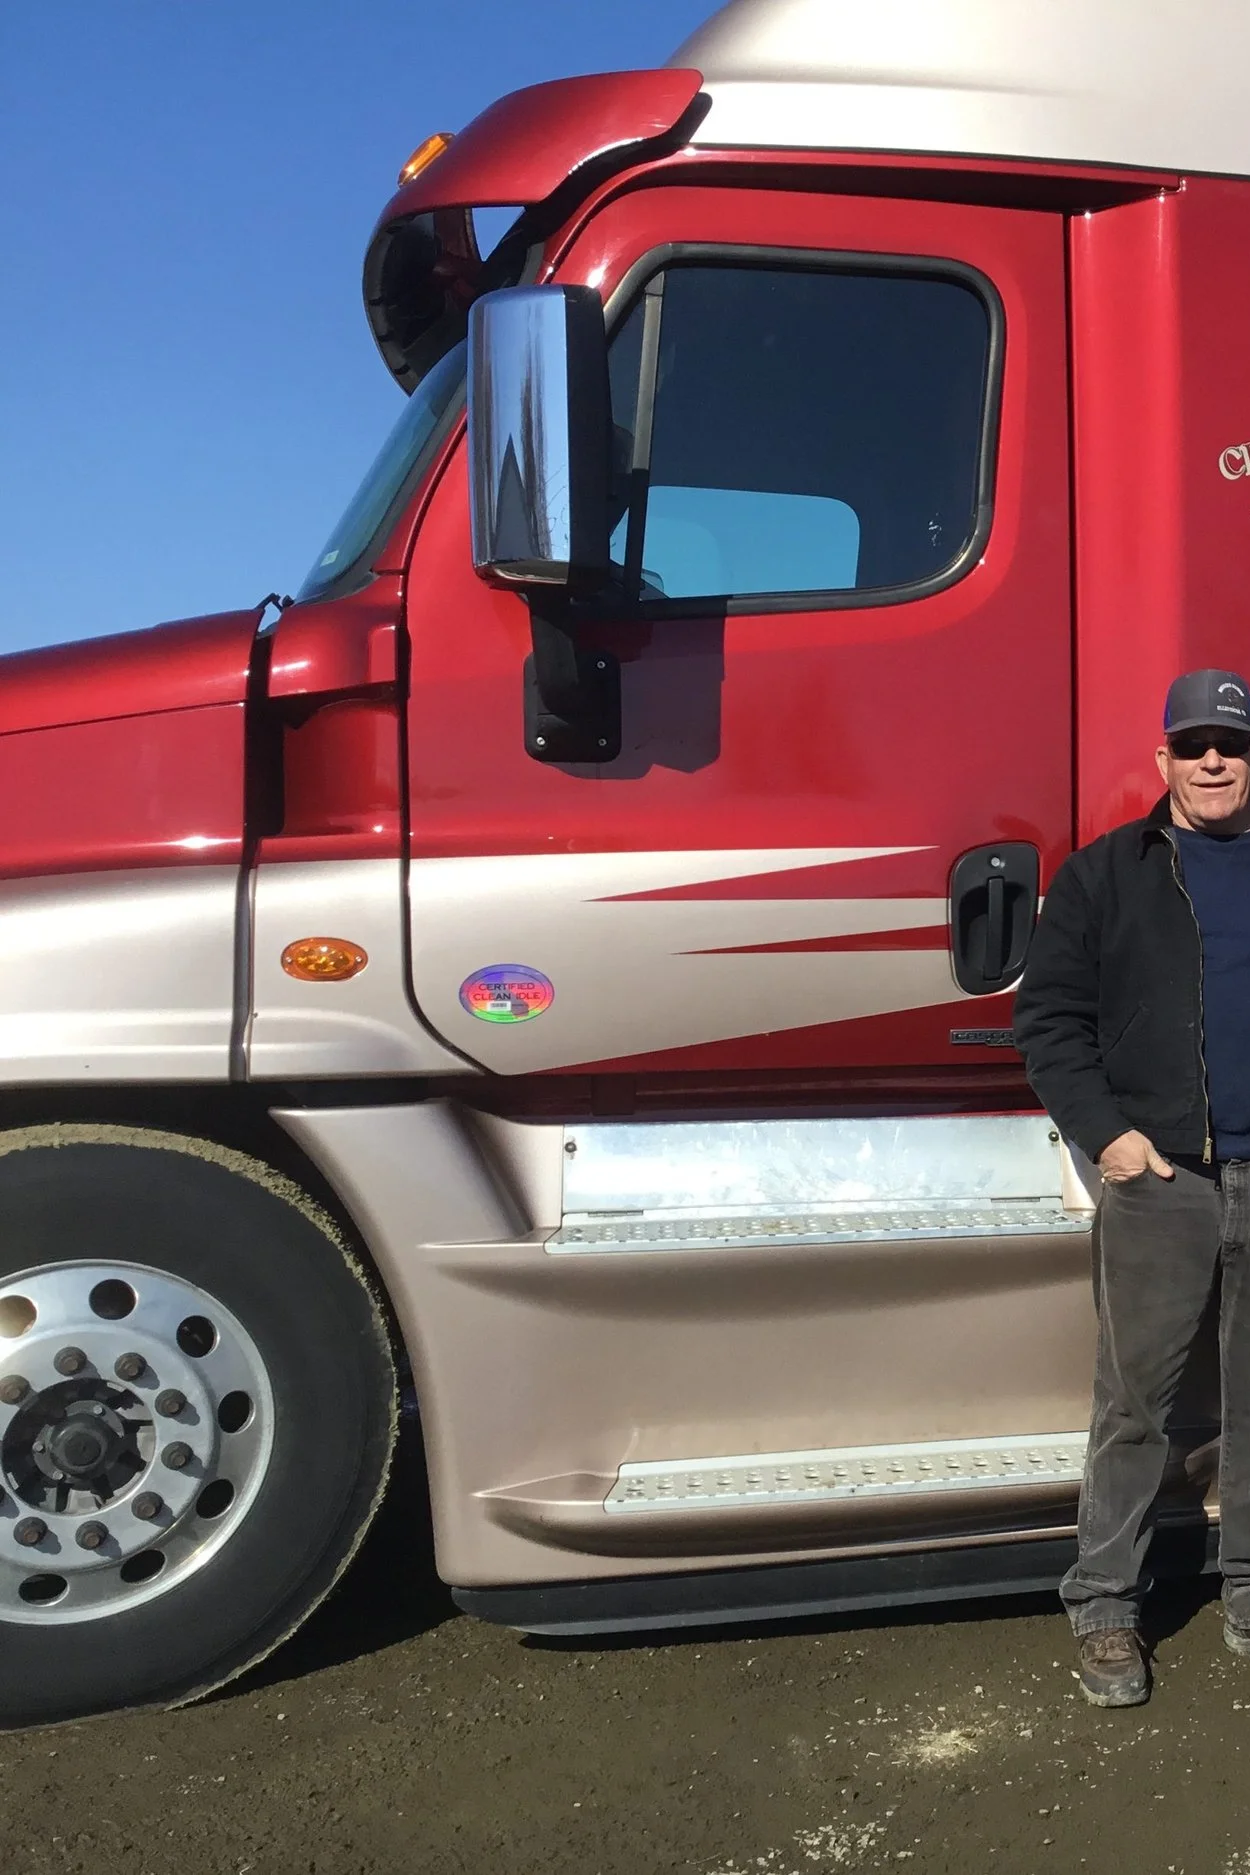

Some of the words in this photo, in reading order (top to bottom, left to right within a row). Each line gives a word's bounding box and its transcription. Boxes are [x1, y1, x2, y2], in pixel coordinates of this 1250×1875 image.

[478, 982, 535, 991] CERTIFIED
[473, 992, 511, 1001] CLEAN
[516, 991, 541, 1000] IDLE
